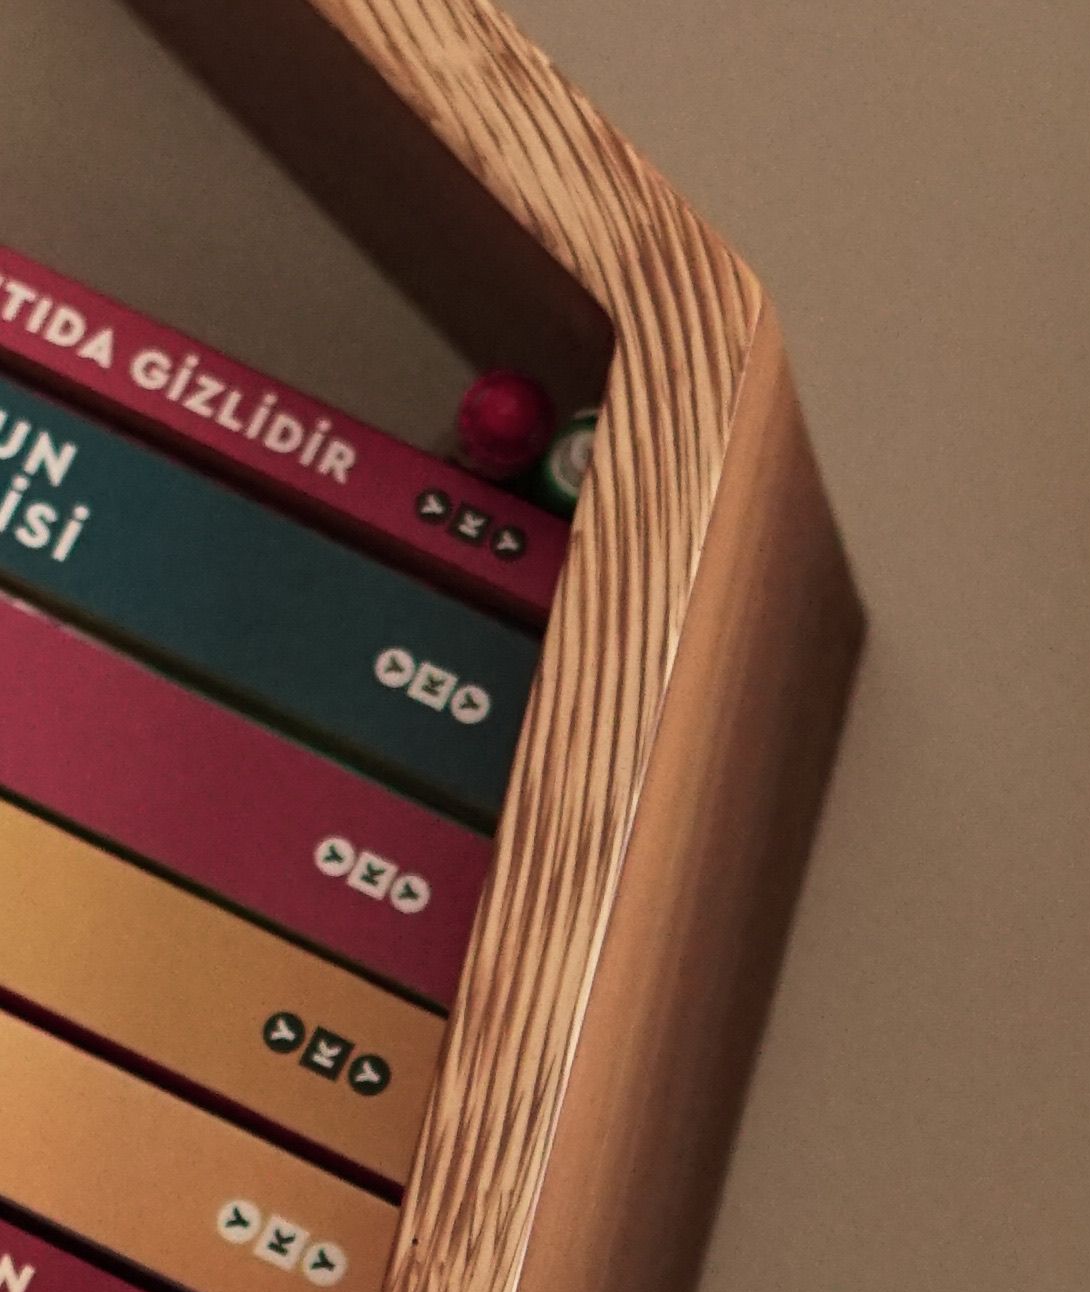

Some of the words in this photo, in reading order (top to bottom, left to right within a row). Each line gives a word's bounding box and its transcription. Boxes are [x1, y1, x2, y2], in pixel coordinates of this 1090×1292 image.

[0, 276, 114, 369] TIDA
[129, 349, 355, 484] GİZLİDİR
[418, 491, 523, 555] YKY
[379, 651, 485, 718] YKY
[319, 841, 424, 908] YKY
[267, 1015, 387, 1090] YKY
[221, 1205, 342, 1280] YKY
